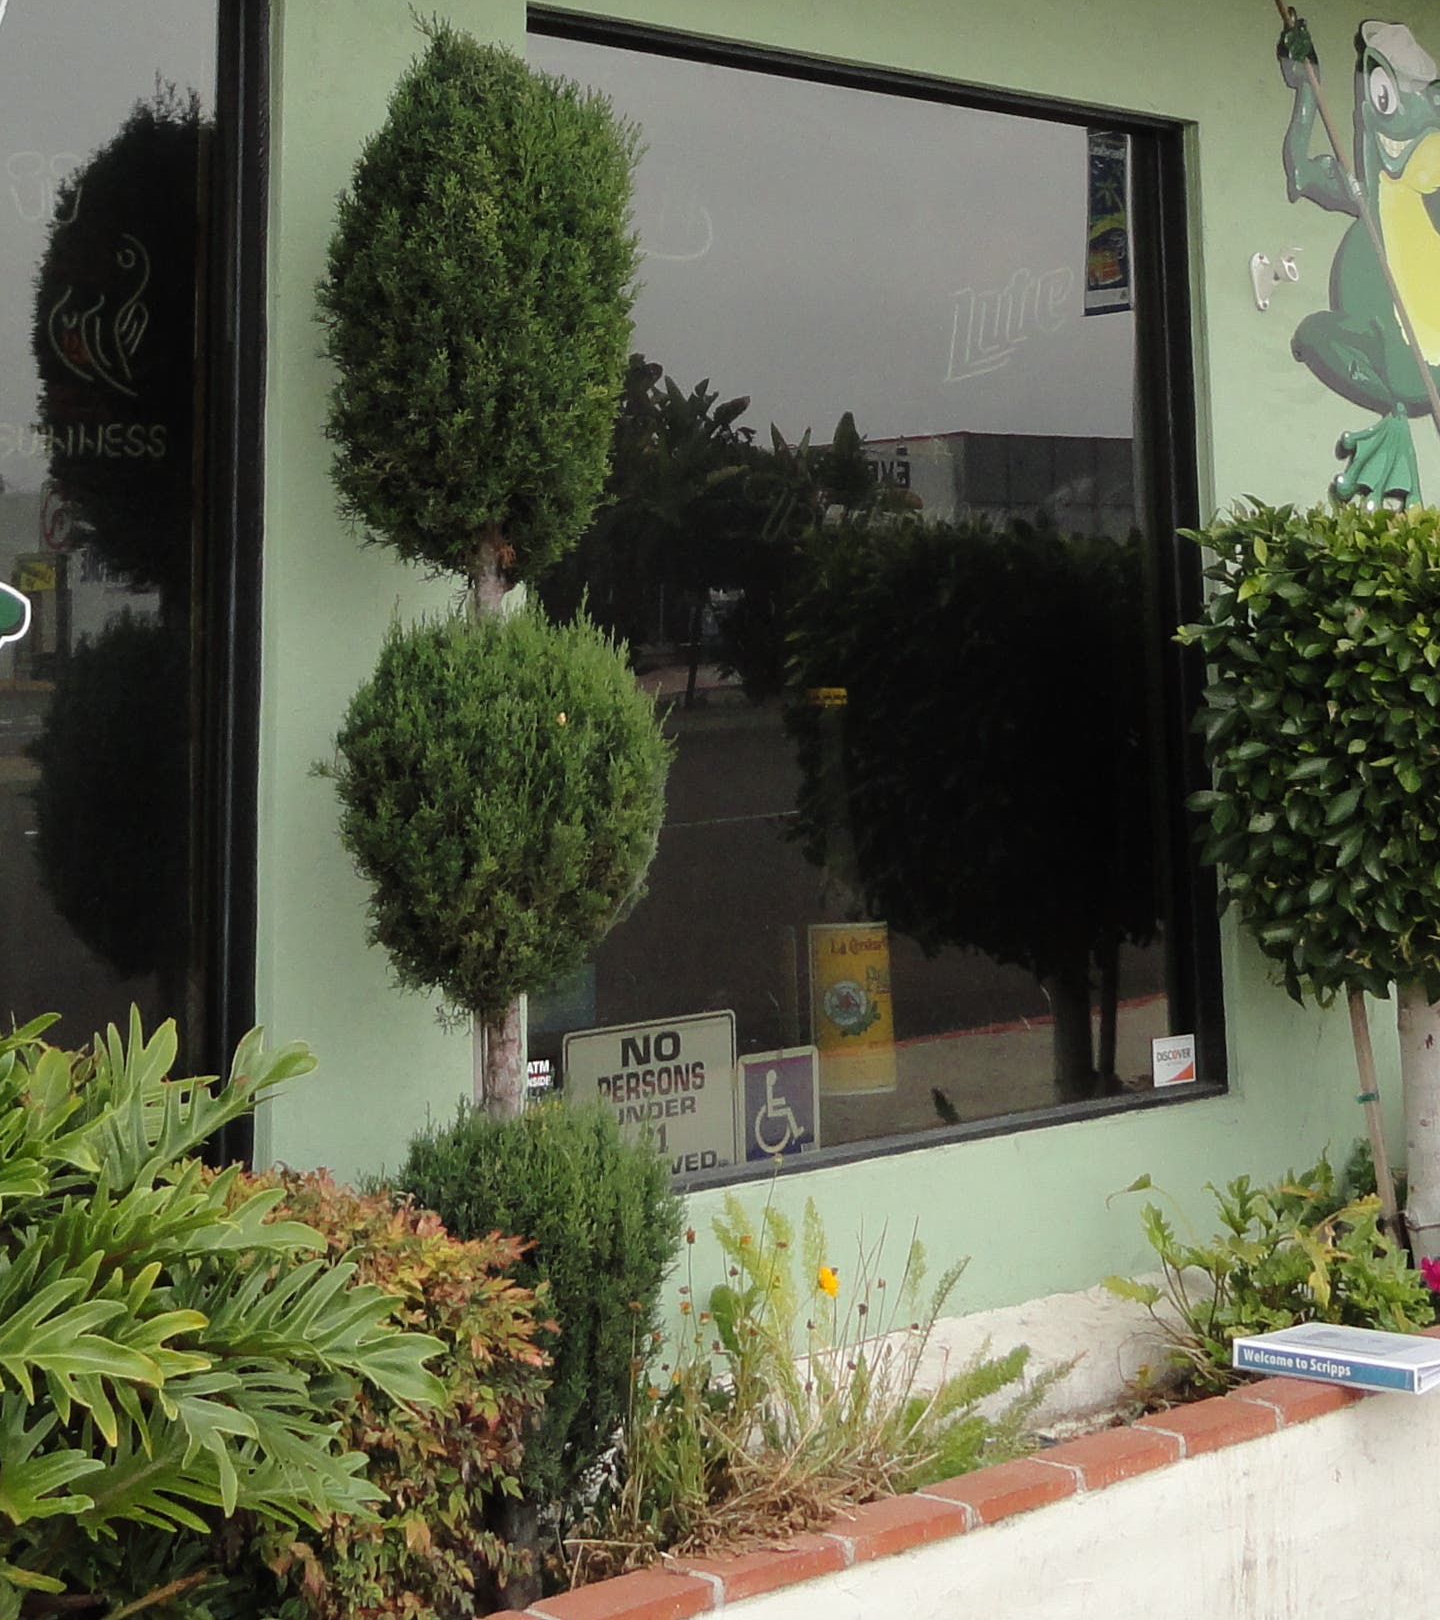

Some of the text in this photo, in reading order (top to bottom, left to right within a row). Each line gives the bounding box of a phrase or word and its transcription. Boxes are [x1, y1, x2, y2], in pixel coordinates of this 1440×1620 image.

[621, 1031, 680, 1068] NO
[1156, 1047, 1192, 1062] DISCOVER
[527, 1060, 550, 1074] ATM
[598, 1061, 705, 1103] PERSONS
[1243, 1348, 1351, 1378] Welcome to Scripps
